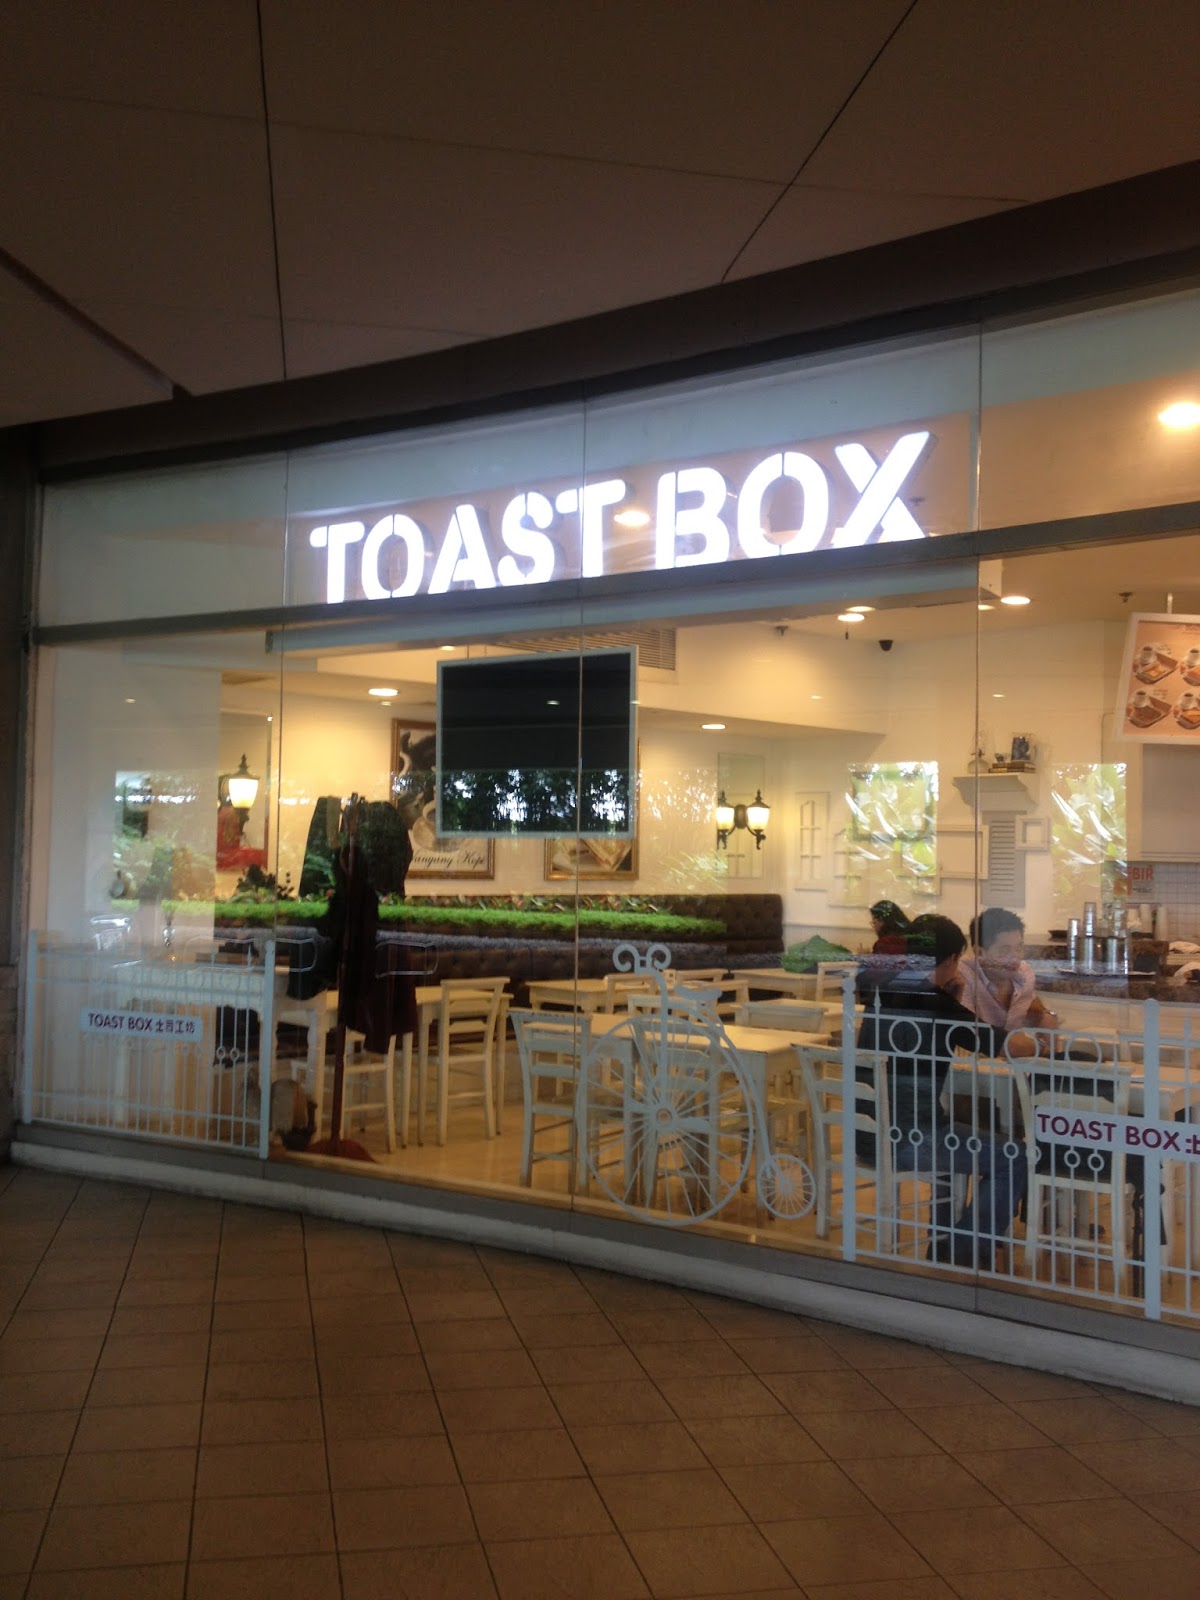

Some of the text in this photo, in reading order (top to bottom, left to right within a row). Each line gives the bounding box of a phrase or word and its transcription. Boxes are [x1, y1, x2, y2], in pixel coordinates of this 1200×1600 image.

[309, 430, 929, 605] TOAST BOX
[88, 1013, 125, 1030] TOAST
[128, 1017, 153, 1032] BOX
[1037, 1113, 1117, 1143] TOAST
[1125, 1125, 1180, 1152] BOX
